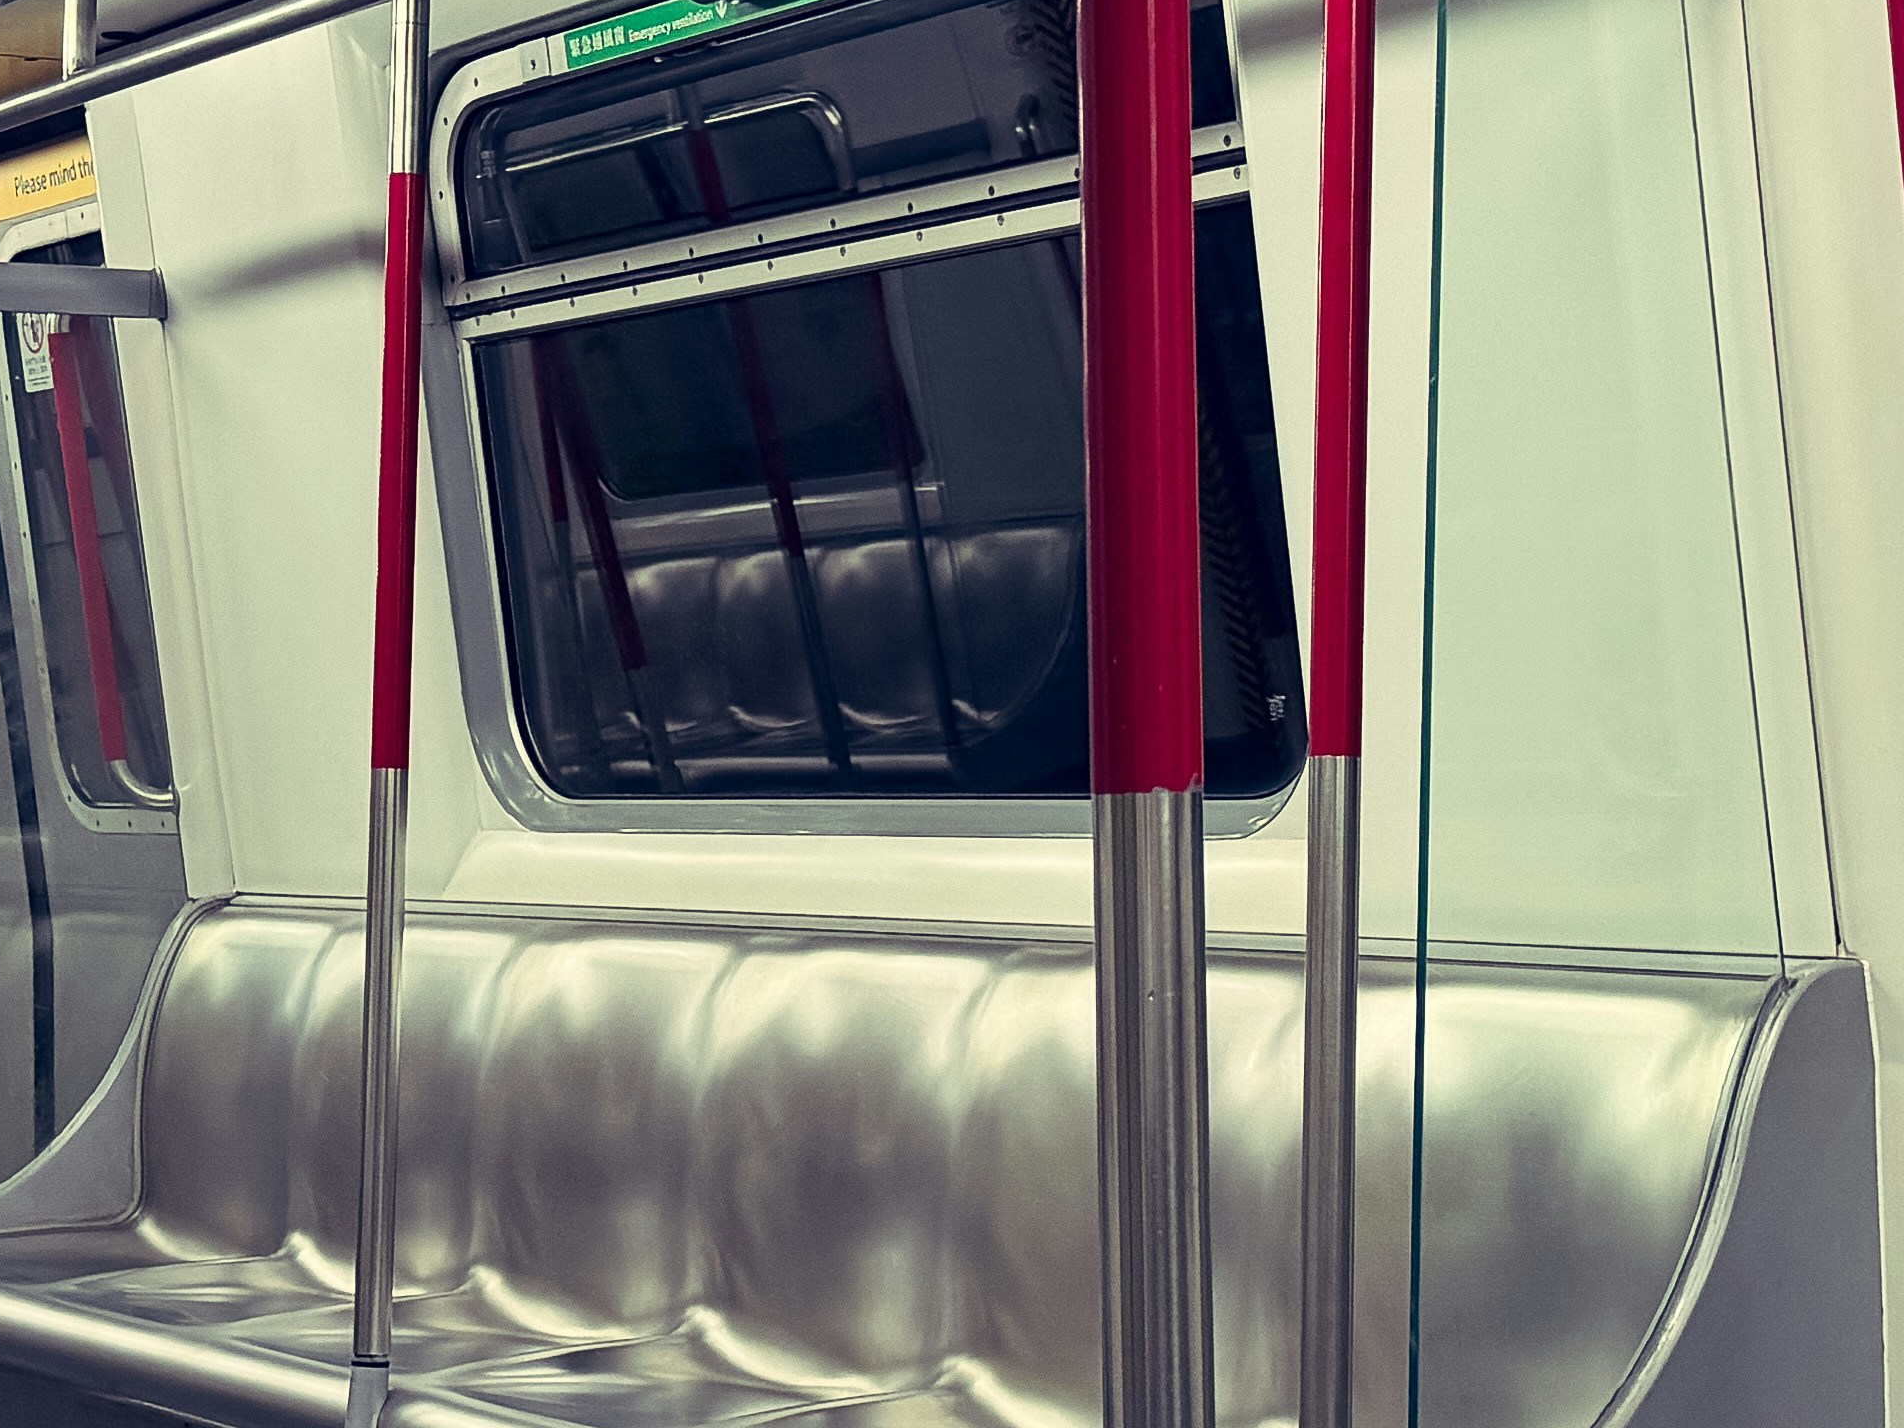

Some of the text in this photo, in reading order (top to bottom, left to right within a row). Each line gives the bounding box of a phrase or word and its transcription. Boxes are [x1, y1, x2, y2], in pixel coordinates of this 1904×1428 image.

[628, 18, 671, 44] Emergency
[14, 174, 47, 198] Please
[49, 158, 77, 187] mind
